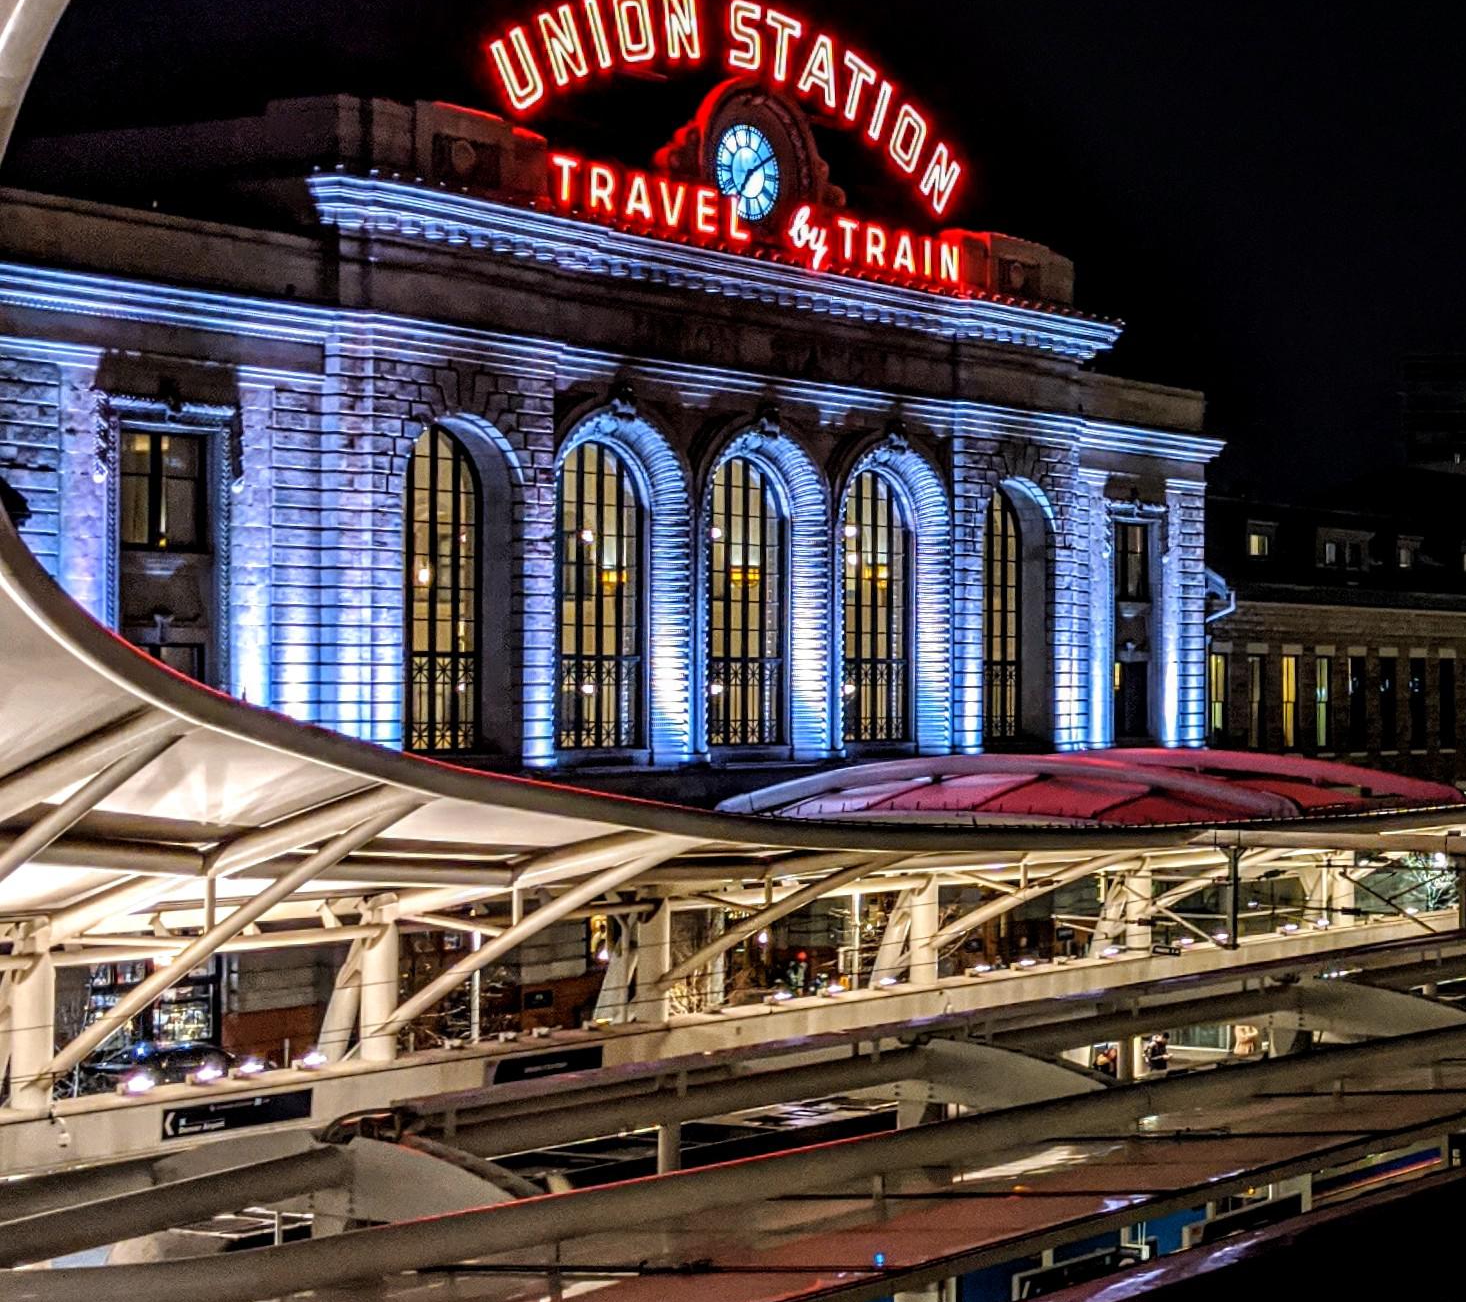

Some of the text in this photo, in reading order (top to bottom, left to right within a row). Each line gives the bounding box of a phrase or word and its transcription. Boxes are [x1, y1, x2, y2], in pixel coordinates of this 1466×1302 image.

[552, 155, 960, 283] TRAVEL by TRAIN
